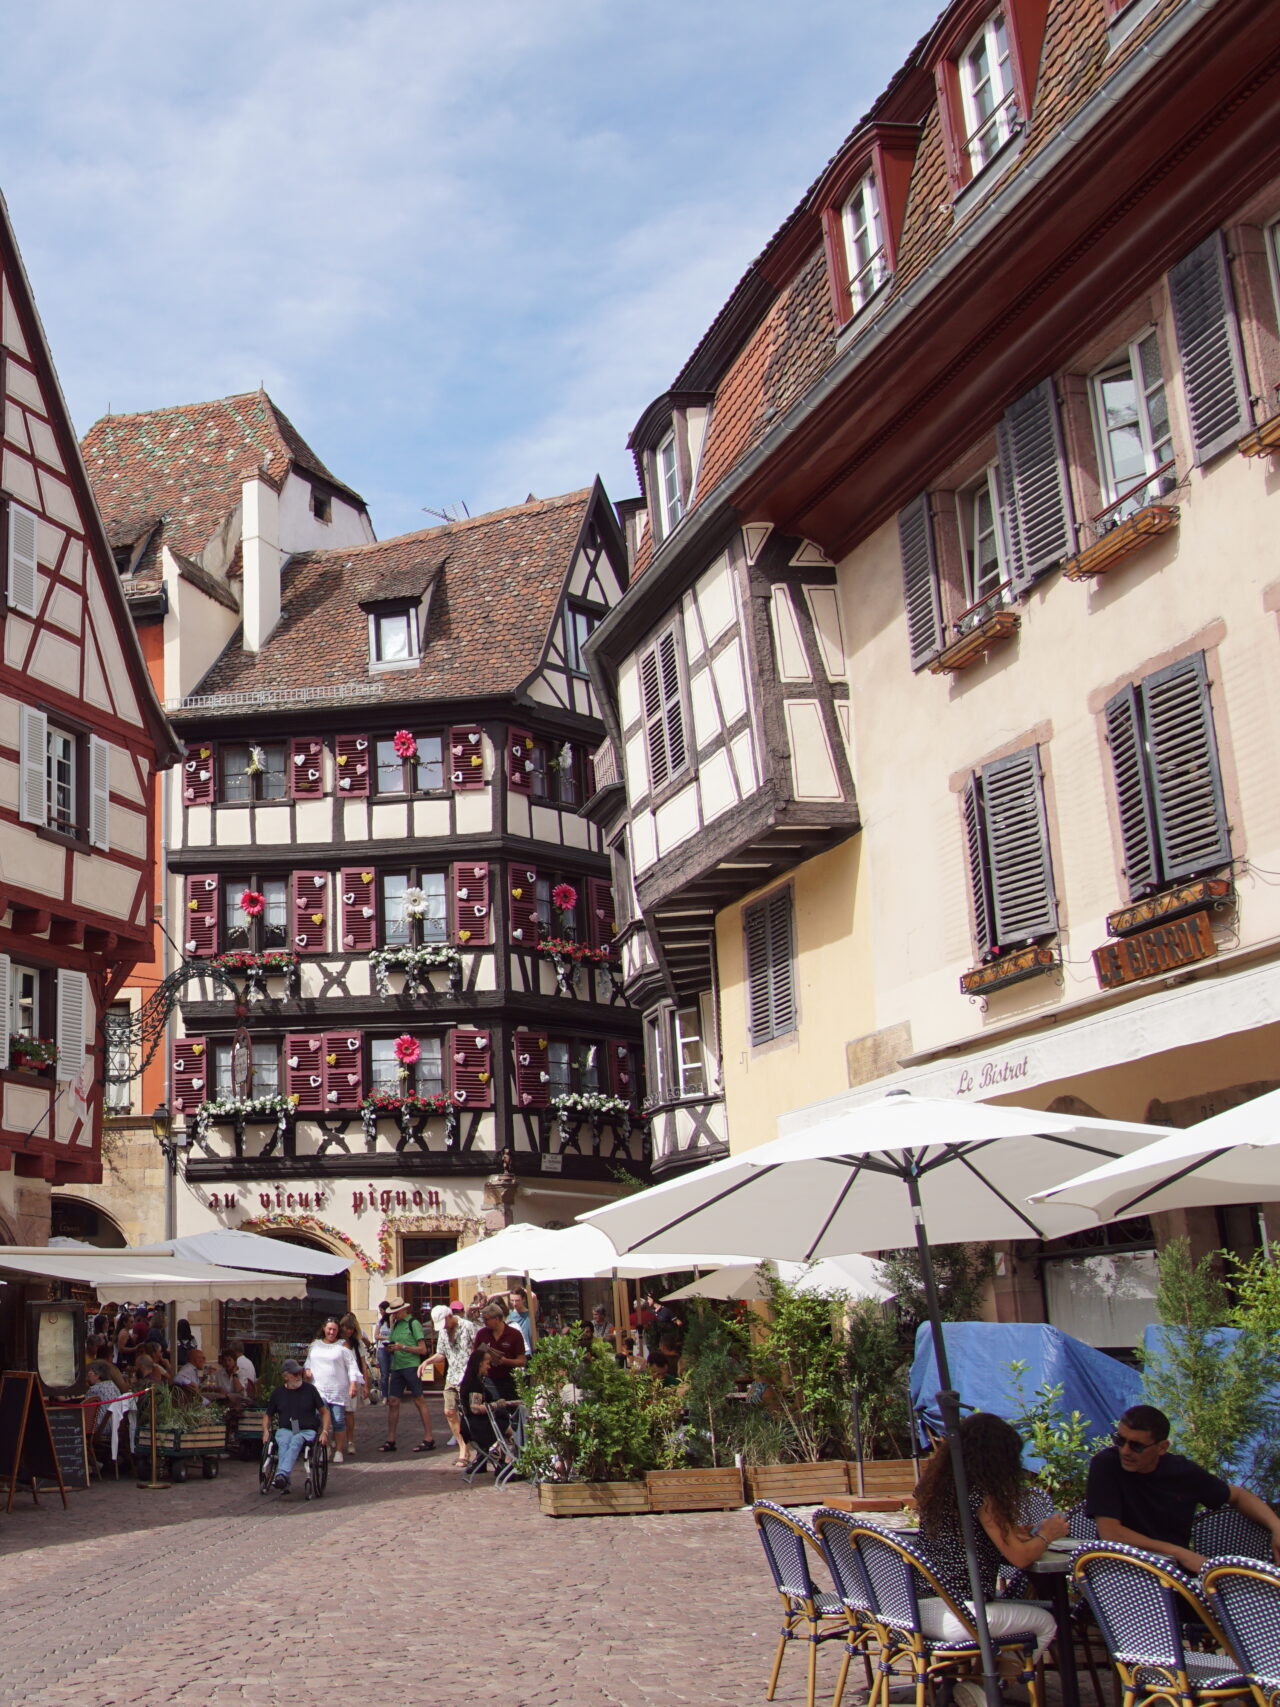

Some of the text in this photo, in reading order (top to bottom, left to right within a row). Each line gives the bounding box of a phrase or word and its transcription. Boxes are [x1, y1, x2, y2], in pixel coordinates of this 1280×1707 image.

[1094, 917, 1205, 983] LE BISTROT
[956, 1056, 1028, 1095] Le Bistrot
[208, 1183, 441, 1214] au vieux pignon
